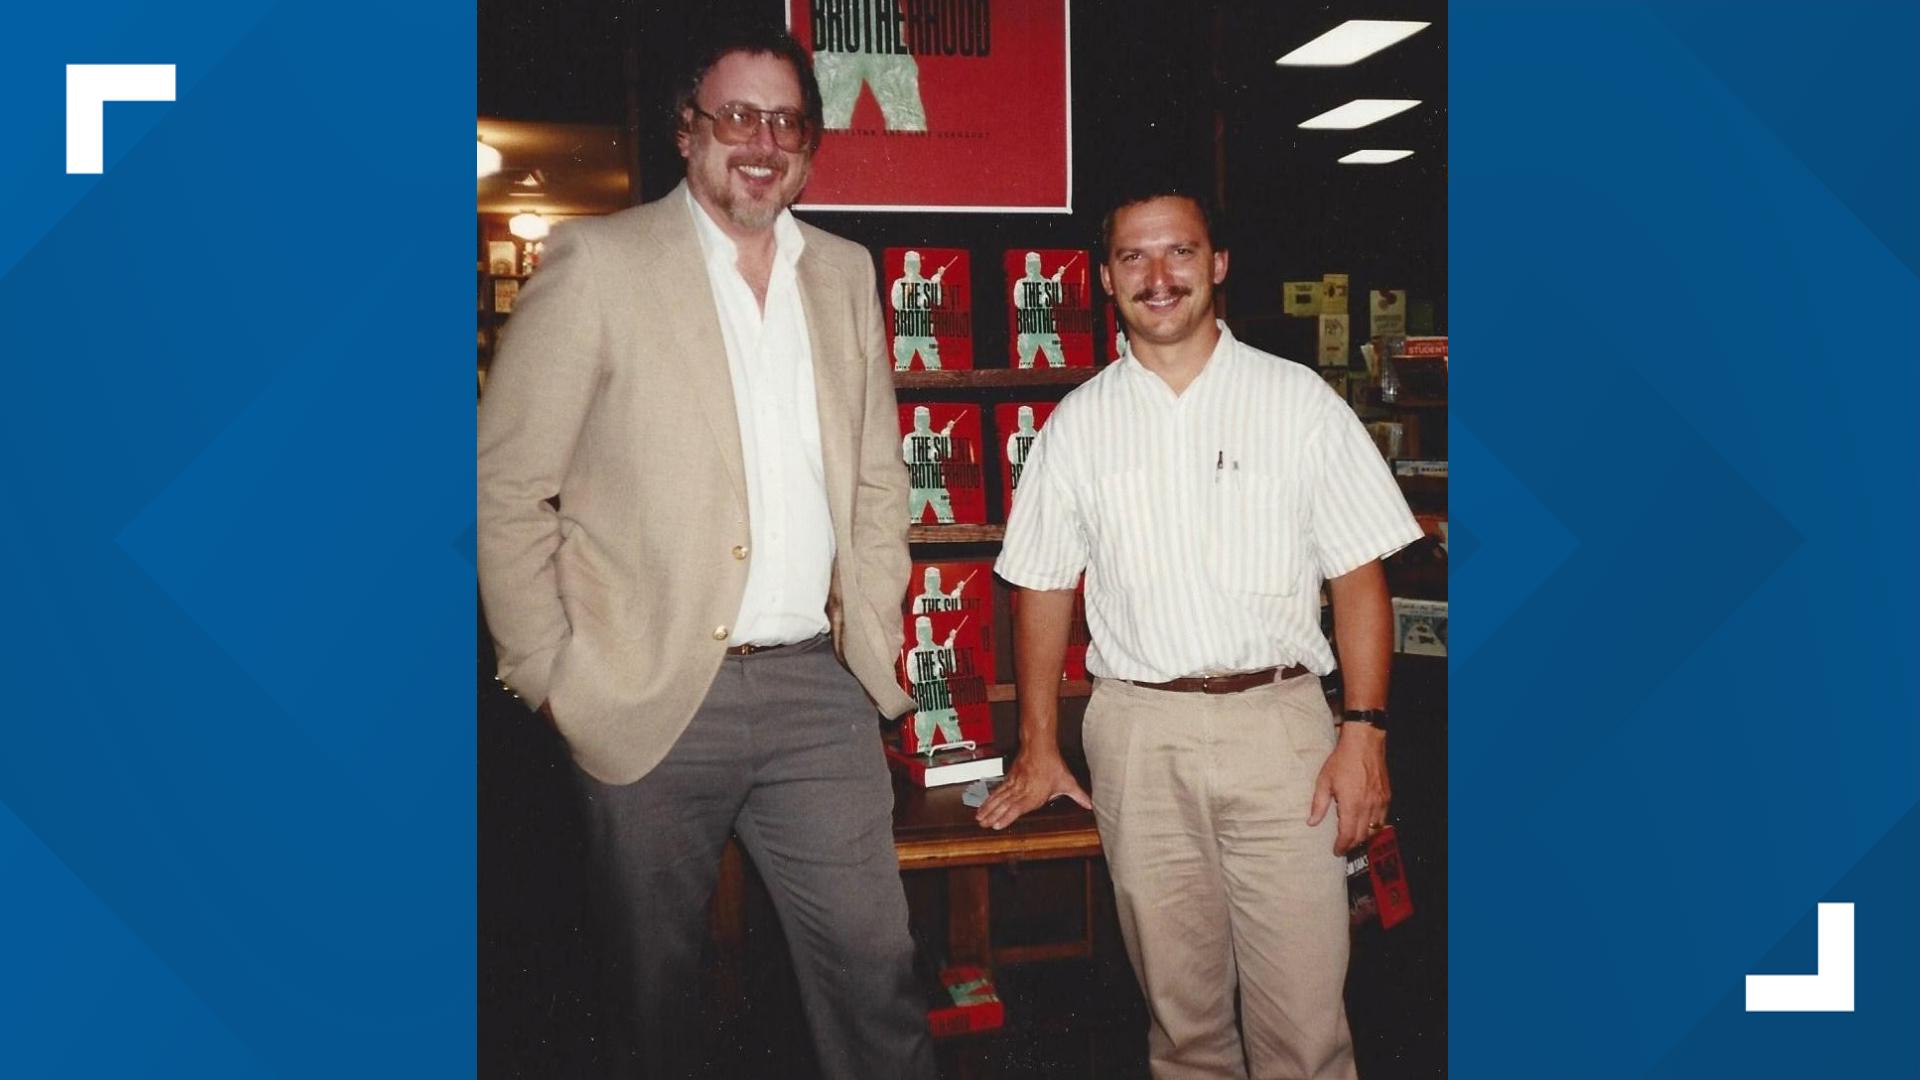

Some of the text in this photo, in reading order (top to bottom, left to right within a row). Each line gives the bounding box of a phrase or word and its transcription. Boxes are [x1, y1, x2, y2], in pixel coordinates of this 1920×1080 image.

[812, 0, 991, 57] BROTHERHOOD
[901, 282, 960, 309] THE SILENT
[1022, 282, 1082, 308] THE SILENT
[894, 309, 970, 337] BROTHERHOOD
[1017, 308, 1092, 334] BROTHERHOOD
[911, 436, 970, 463] THE SILENT
[915, 646, 975, 682] THE SILENT
